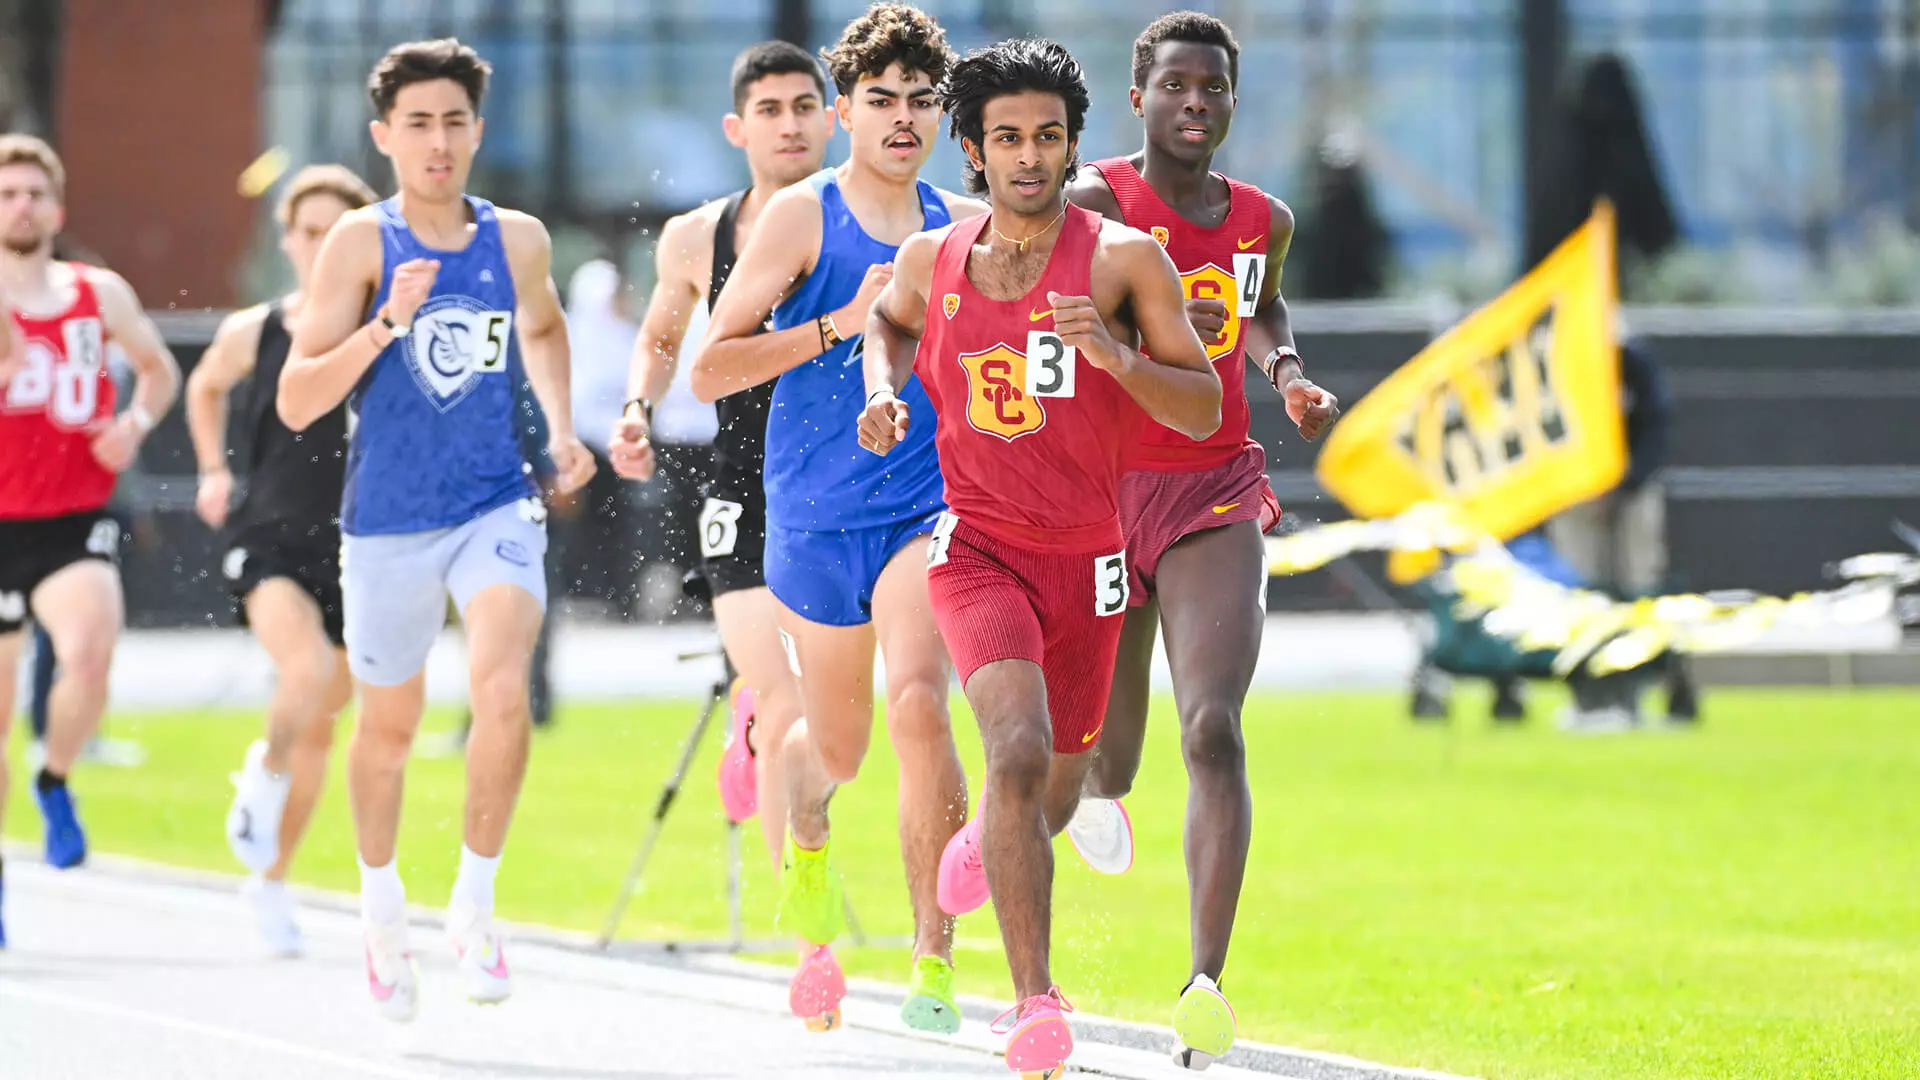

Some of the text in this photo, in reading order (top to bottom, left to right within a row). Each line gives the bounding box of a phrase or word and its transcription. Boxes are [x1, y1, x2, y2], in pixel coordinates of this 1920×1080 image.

[1243, 258, 1259, 313] 4
[484, 317, 504, 367] 5
[1036, 335, 1065, 394] 3
[980, 360, 1026, 425] SC
[707, 506, 730, 548] 6
[1104, 557, 1125, 612] 3
